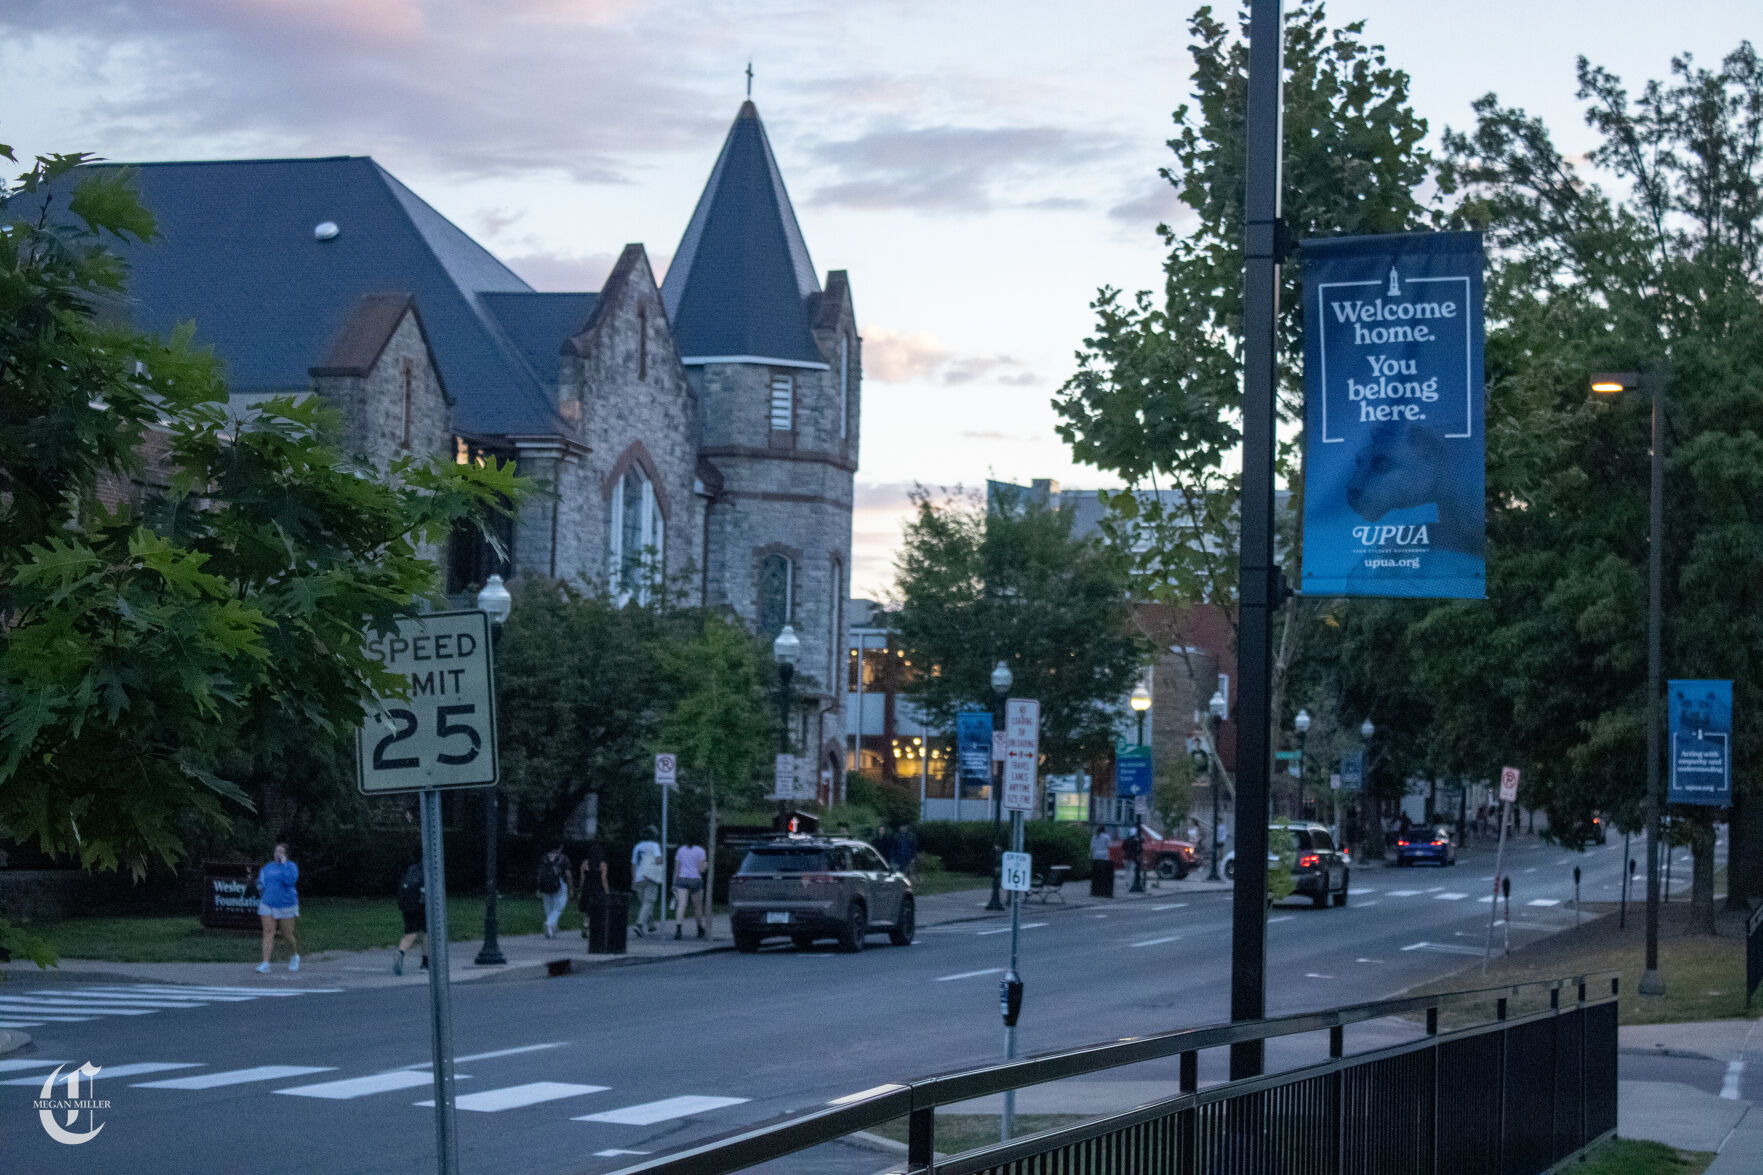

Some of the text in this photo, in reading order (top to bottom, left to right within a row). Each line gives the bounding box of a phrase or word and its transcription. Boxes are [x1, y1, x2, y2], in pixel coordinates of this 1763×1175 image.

[1330, 298, 1457, 323] Welcome
[1353, 323, 1436, 345] home.
[1366, 354, 1418, 377] You
[1347, 376, 1440, 402] belong
[1359, 401, 1427, 422] here.
[1352, 524, 1430, 546] UPUA
[1364, 557, 1421, 569] upua.org
[368, 633, 477, 663] SPEED
[412, 669, 466, 697] MIT
[373, 703, 482, 770] 25
[213, 880, 248, 896] Wesley
[1008, 868, 1026, 886] 161
